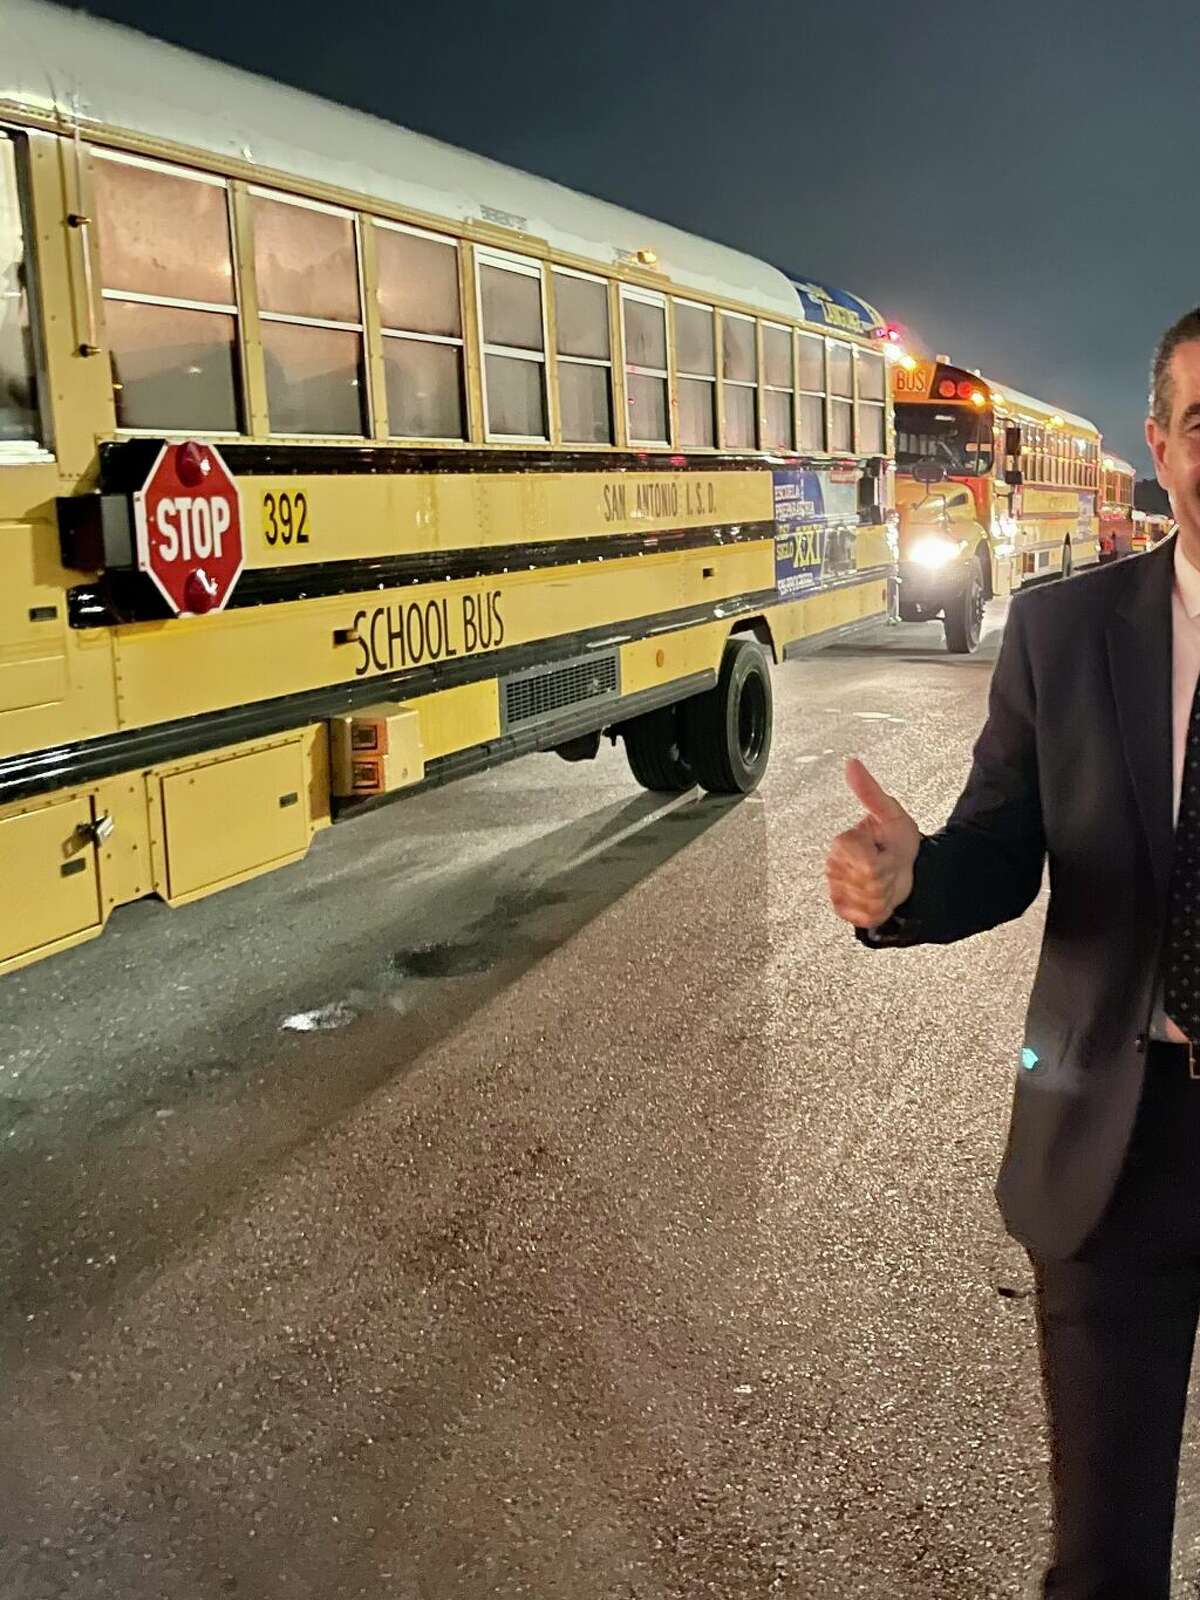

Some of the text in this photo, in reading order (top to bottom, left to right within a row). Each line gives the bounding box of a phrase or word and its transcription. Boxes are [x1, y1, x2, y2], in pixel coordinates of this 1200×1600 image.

[896, 369, 926, 391] BUS
[263, 493, 309, 545] 392
[603, 484, 626, 522] SAN
[636, 482, 678, 518] ANTONIO
[156, 496, 230, 562] STOP
[353, 590, 504, 676] SCHOOL BUS
